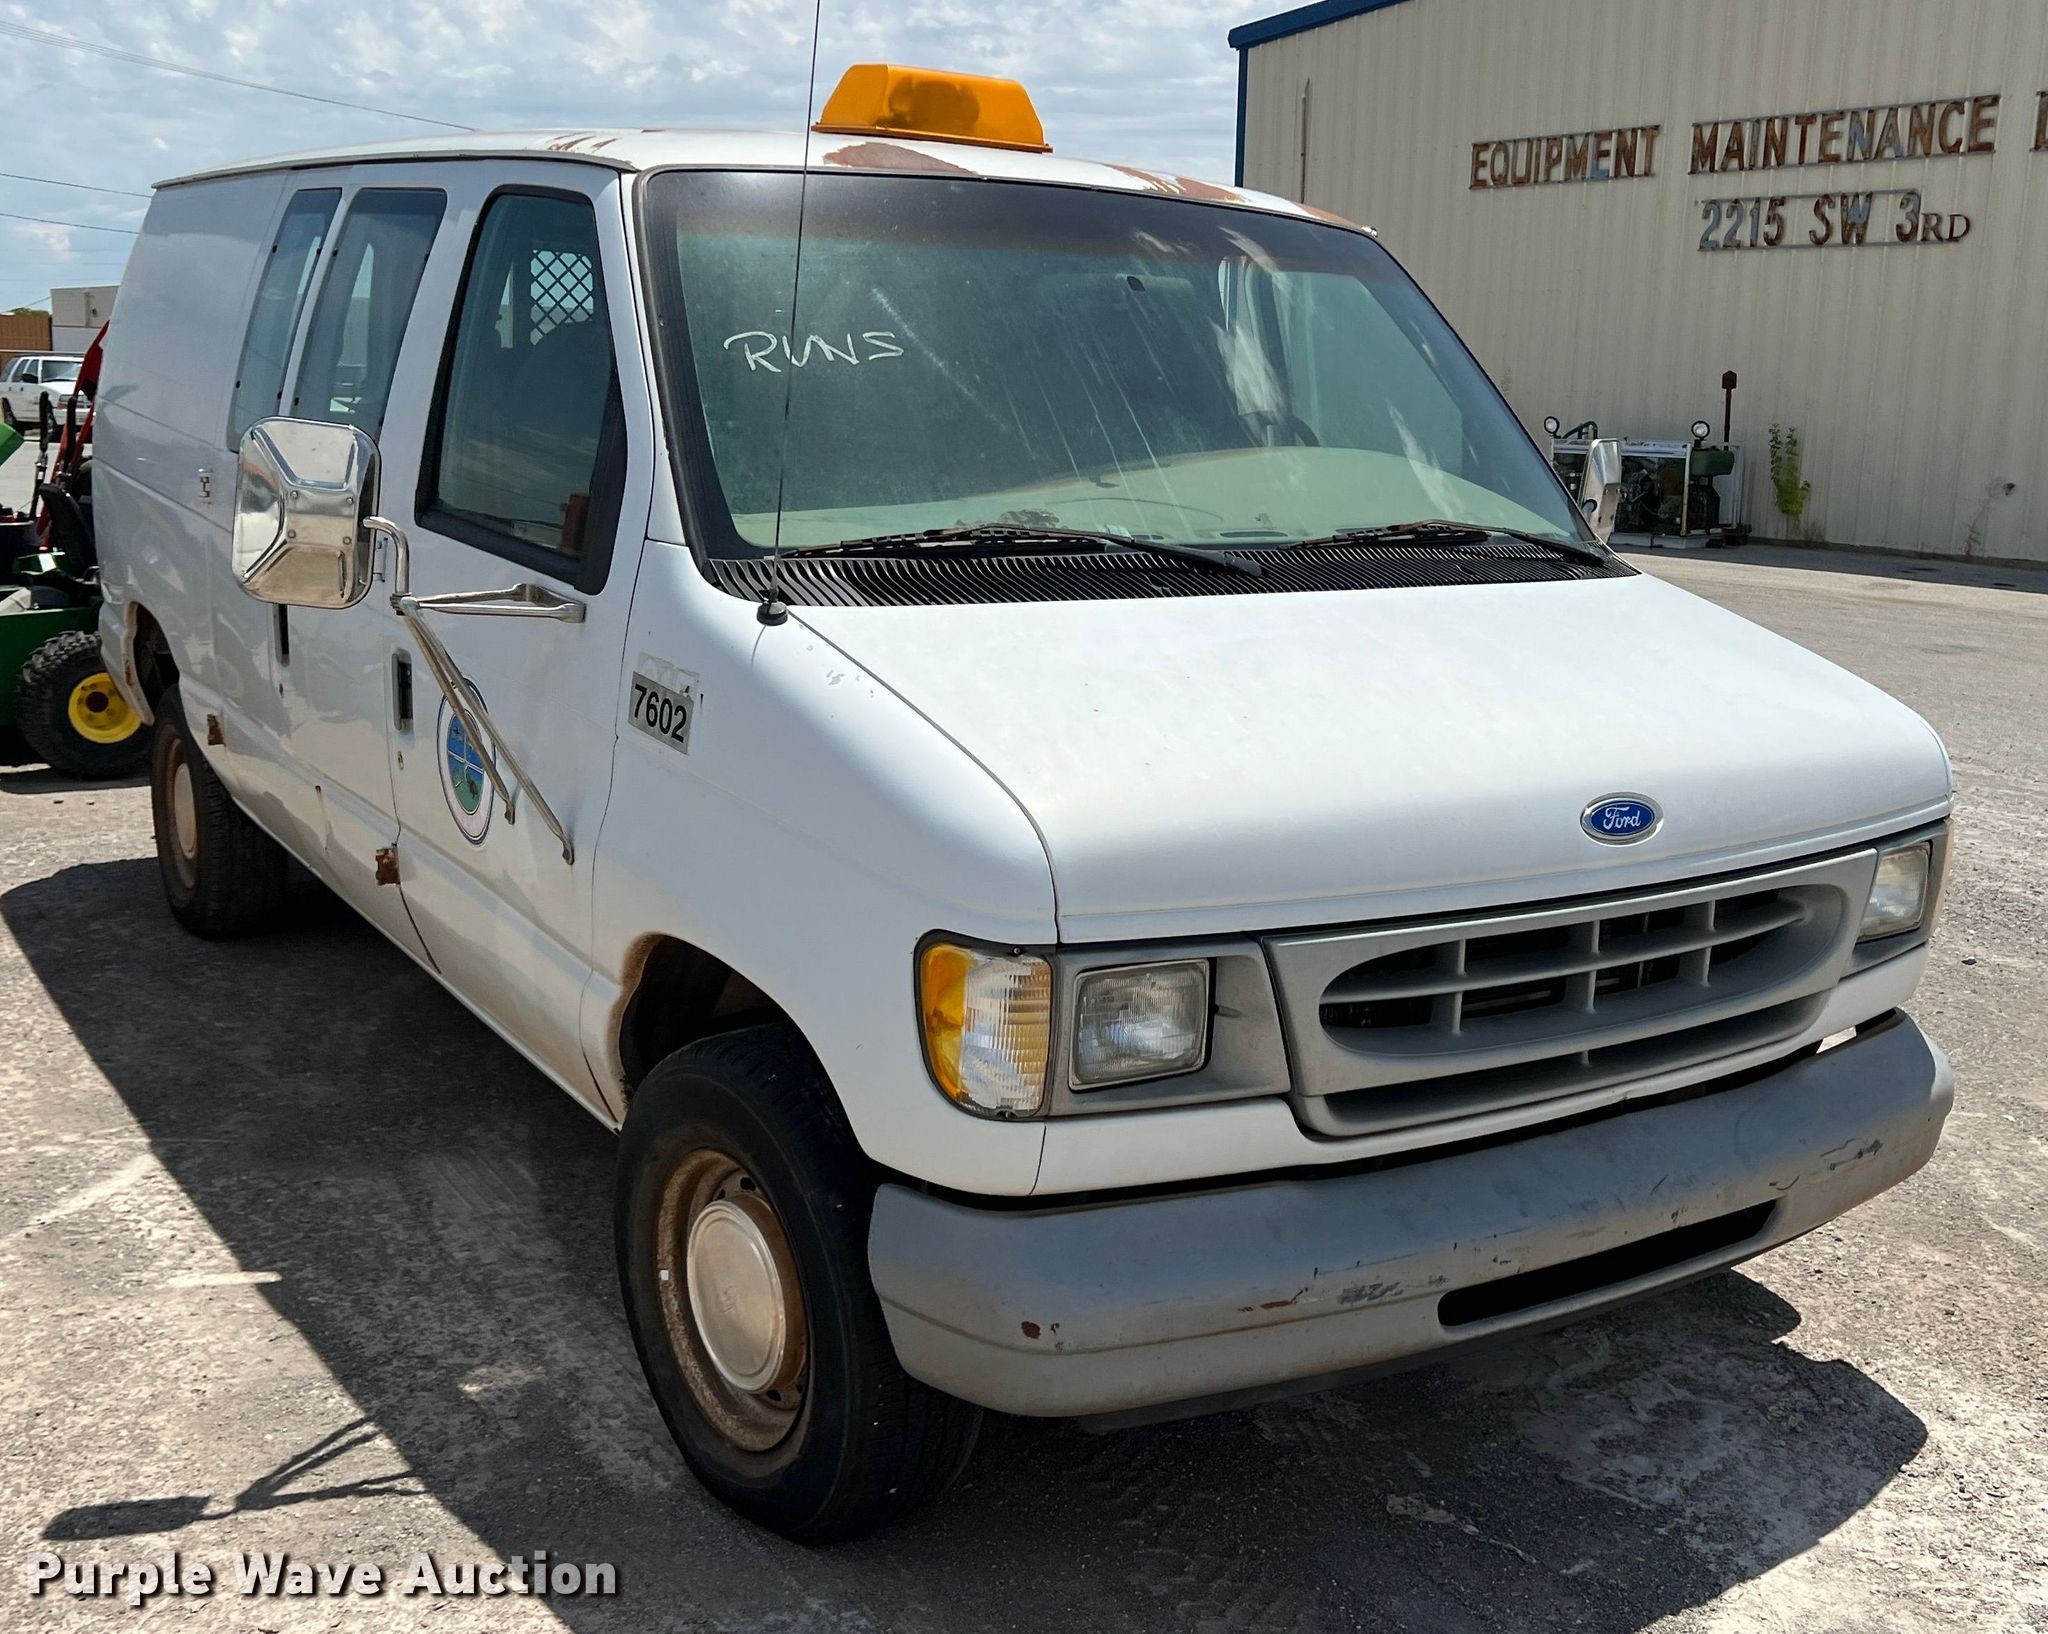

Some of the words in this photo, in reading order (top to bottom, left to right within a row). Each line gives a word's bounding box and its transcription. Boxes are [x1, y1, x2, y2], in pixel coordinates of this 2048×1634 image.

[1470, 126, 1660, 188] EQUIPMENT
[1690, 96, 2000, 174] MAINTENANCE
[1701, 198, 1786, 249] 2215
[1809, 193, 1873, 246] SW
[1896, 191, 1971, 244] 3RD
[634, 683, 687, 743] 7602
[1602, 806, 1642, 830] Ford
